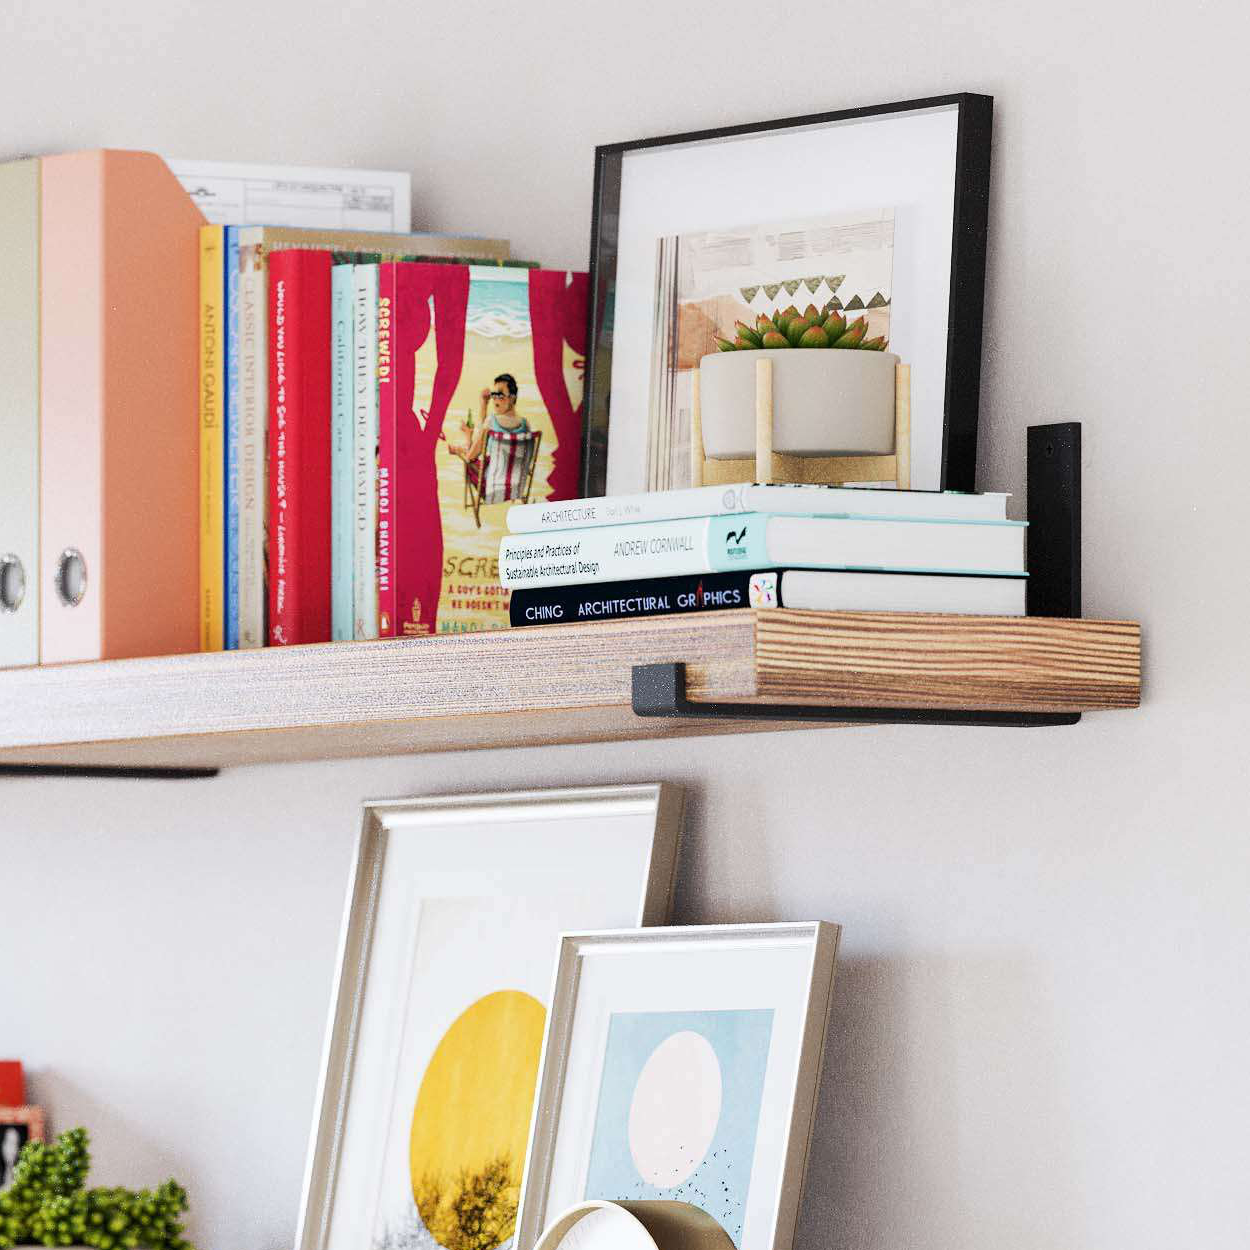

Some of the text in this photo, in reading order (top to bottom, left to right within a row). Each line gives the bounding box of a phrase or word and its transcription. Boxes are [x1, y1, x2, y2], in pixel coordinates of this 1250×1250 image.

[203, 304, 215, 368] ANTONI
[245, 278, 254, 350] CLASSIC
[336, 320, 345, 406] California
[245, 355, 254, 437] INTERIOR
[358, 287, 367, 531] HOW THEY DECORATED
[245, 443, 254, 510] DESIGN
[541, 507, 597, 524] ARCHITECTURE
[613, 536, 694, 557] ANDREW CORNWALL
[505, 541, 581, 562] Principles and Practices of
[505, 561, 600, 580] Sustainable Architectural Design
[525, 604, 564, 620] CHING
[577, 595, 671, 616] ARCHITECTURAL
[676, 582, 742, 608] GRAPHICS
